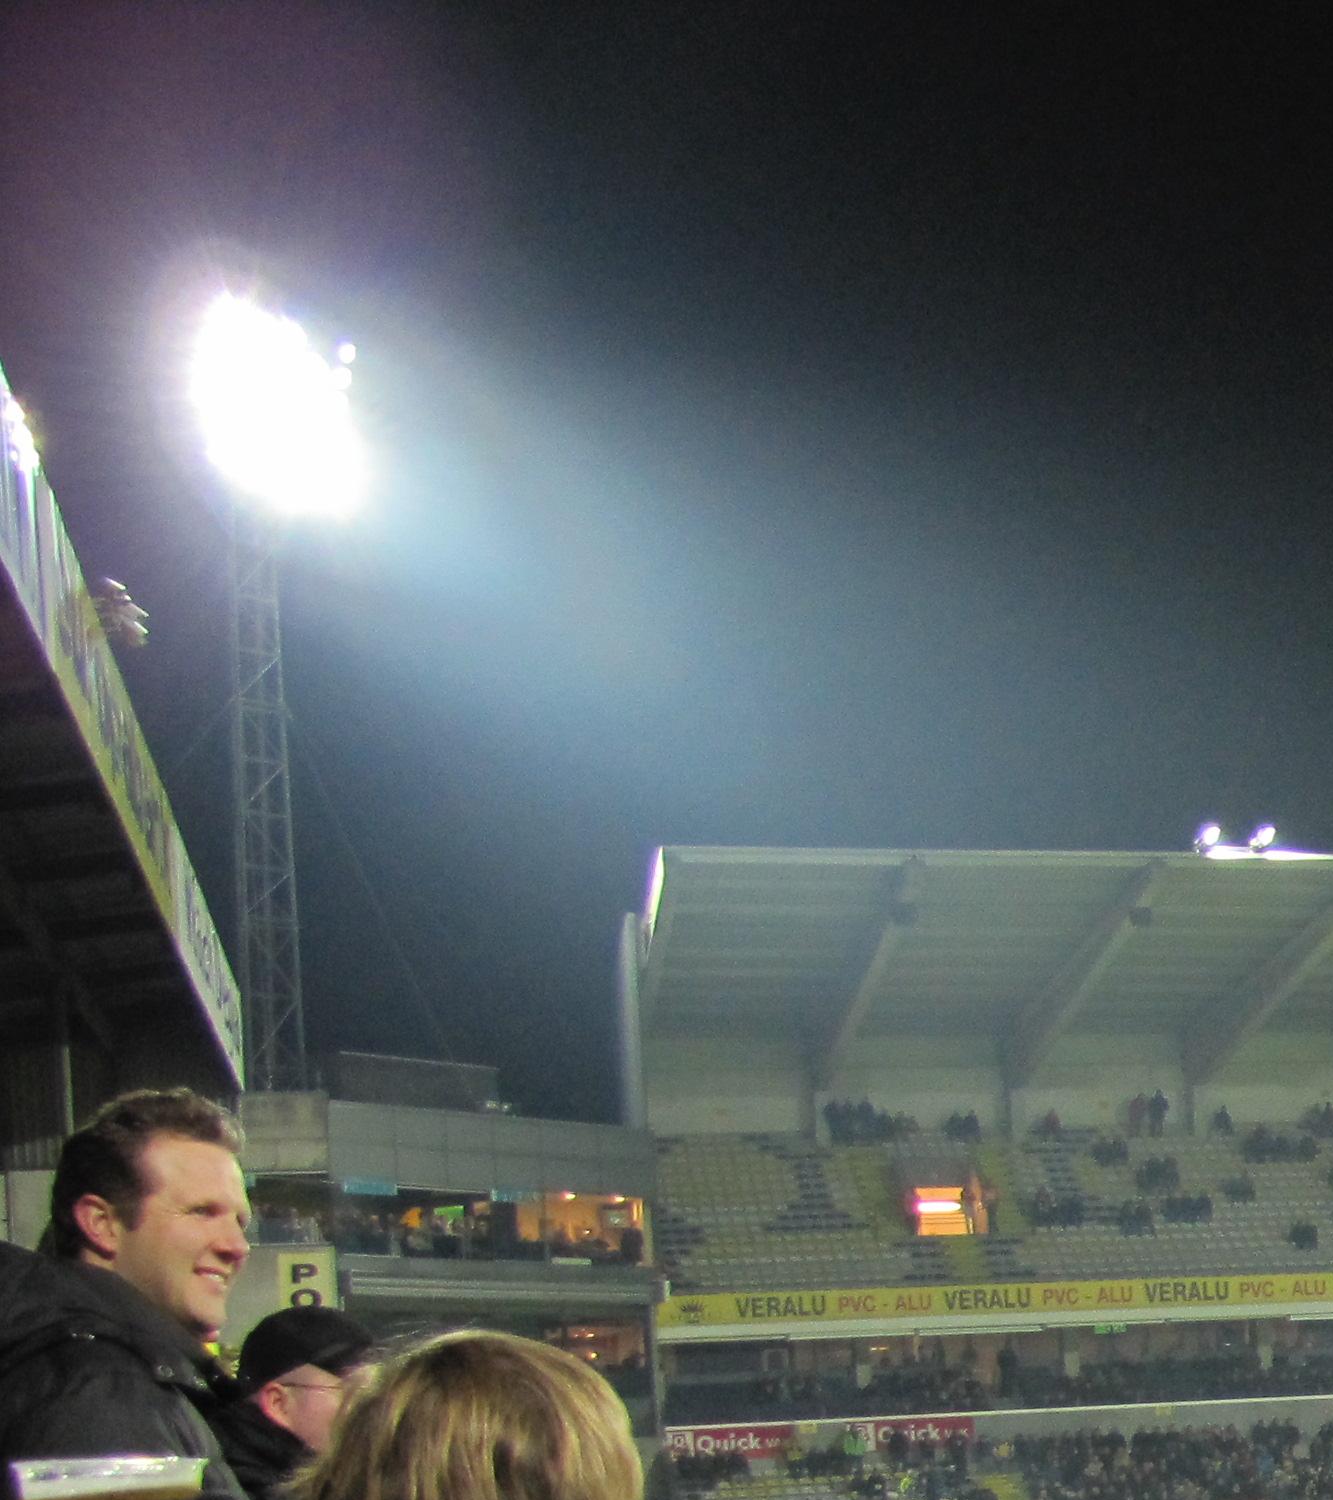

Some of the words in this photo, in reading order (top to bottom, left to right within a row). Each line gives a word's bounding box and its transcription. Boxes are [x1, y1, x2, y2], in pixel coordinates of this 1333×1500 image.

[735, 1295, 827, 1318] VERALU
[838, 1293, 876, 1312] PVC
[895, 1291, 932, 1311] ALU
[944, 1289, 1031, 1311] VERALU
[1043, 1287, 1079, 1305] PVC
[1097, 1286, 1133, 1303] ALU
[1145, 1281, 1229, 1303] VERALU
[1239, 1281, 1275, 1298] PVC
[1291, 1279, 1326, 1296] ALU
[698, 1432, 761, 1454] Quick
